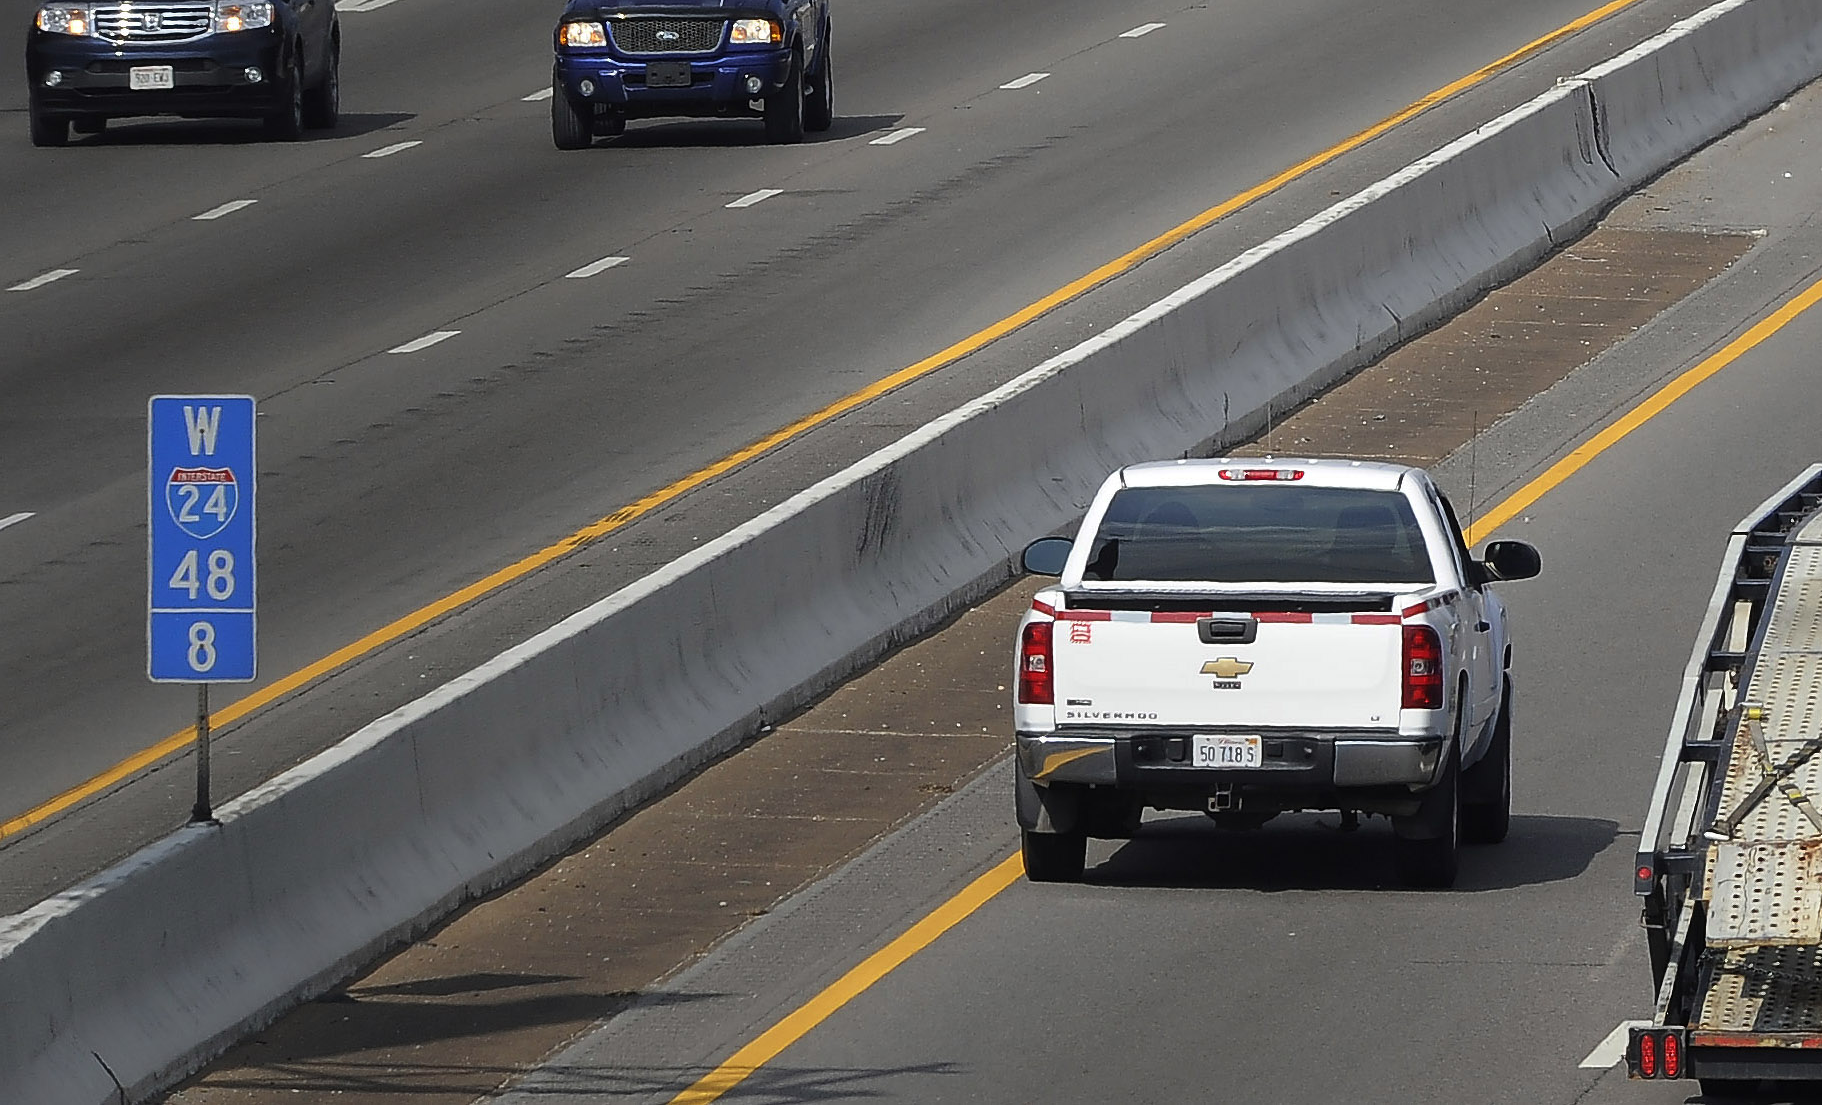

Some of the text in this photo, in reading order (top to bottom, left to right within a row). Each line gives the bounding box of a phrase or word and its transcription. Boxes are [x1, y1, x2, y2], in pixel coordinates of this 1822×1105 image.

[182, 405, 222, 456] W
[177, 472, 227, 482] INTERSTATE
[178, 484, 227, 523] 24
[168, 549, 235, 601] 48
[187, 620, 217, 673] 8
[1200, 745, 1216, 762] 50
[1220, 745, 1243, 763] 718
